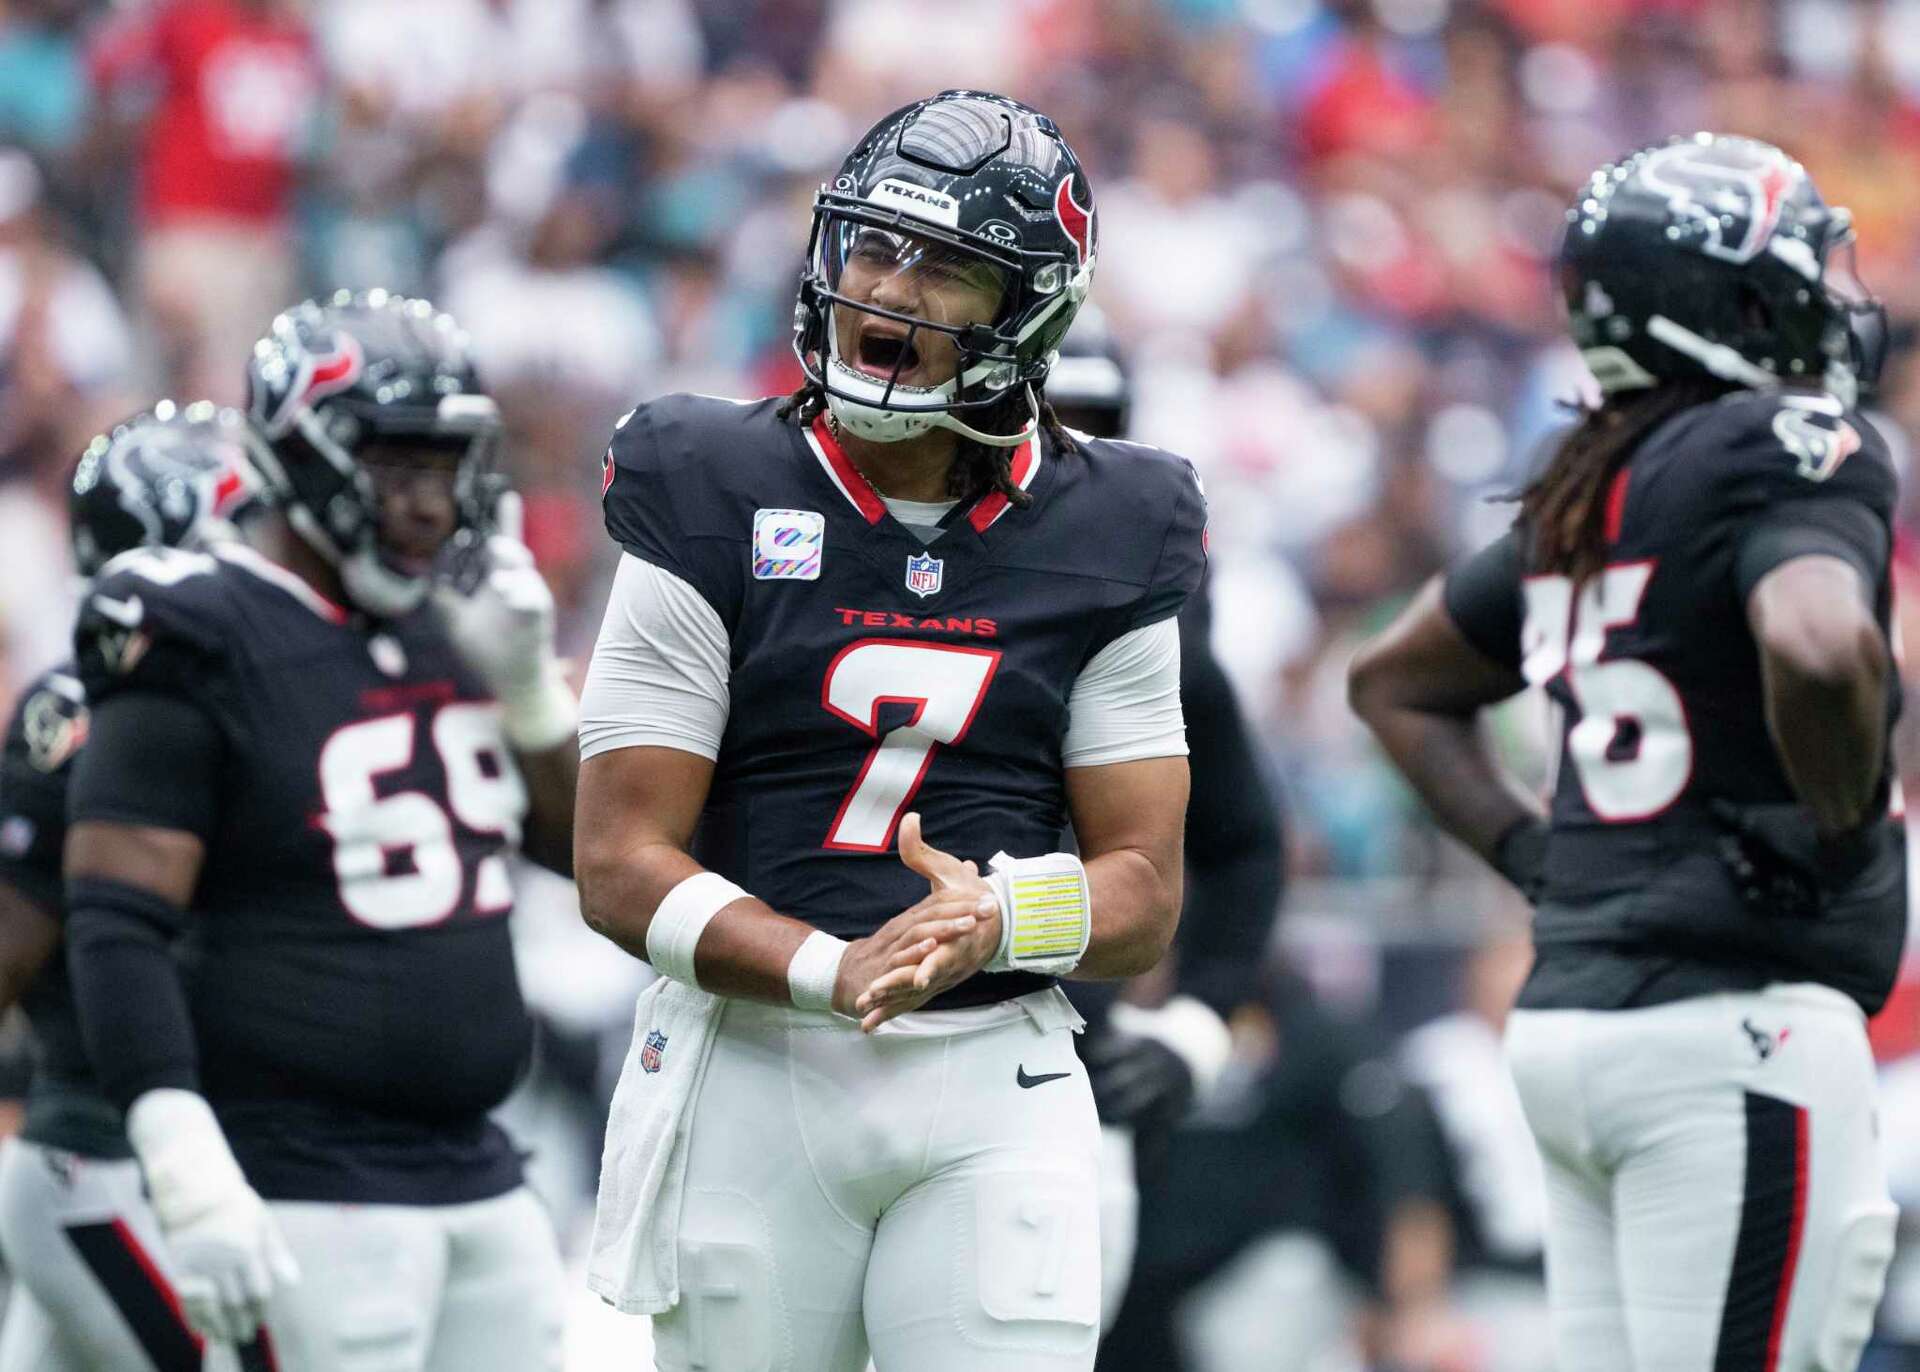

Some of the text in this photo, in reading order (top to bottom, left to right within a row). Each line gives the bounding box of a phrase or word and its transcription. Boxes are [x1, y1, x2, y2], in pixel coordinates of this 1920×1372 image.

[883, 183, 951, 210] TEXANS
[911, 571, 937, 589] NFL
[834, 607, 998, 637] TEXANS
[821, 638, 1003, 852] 7
[317, 703, 528, 930] 69
